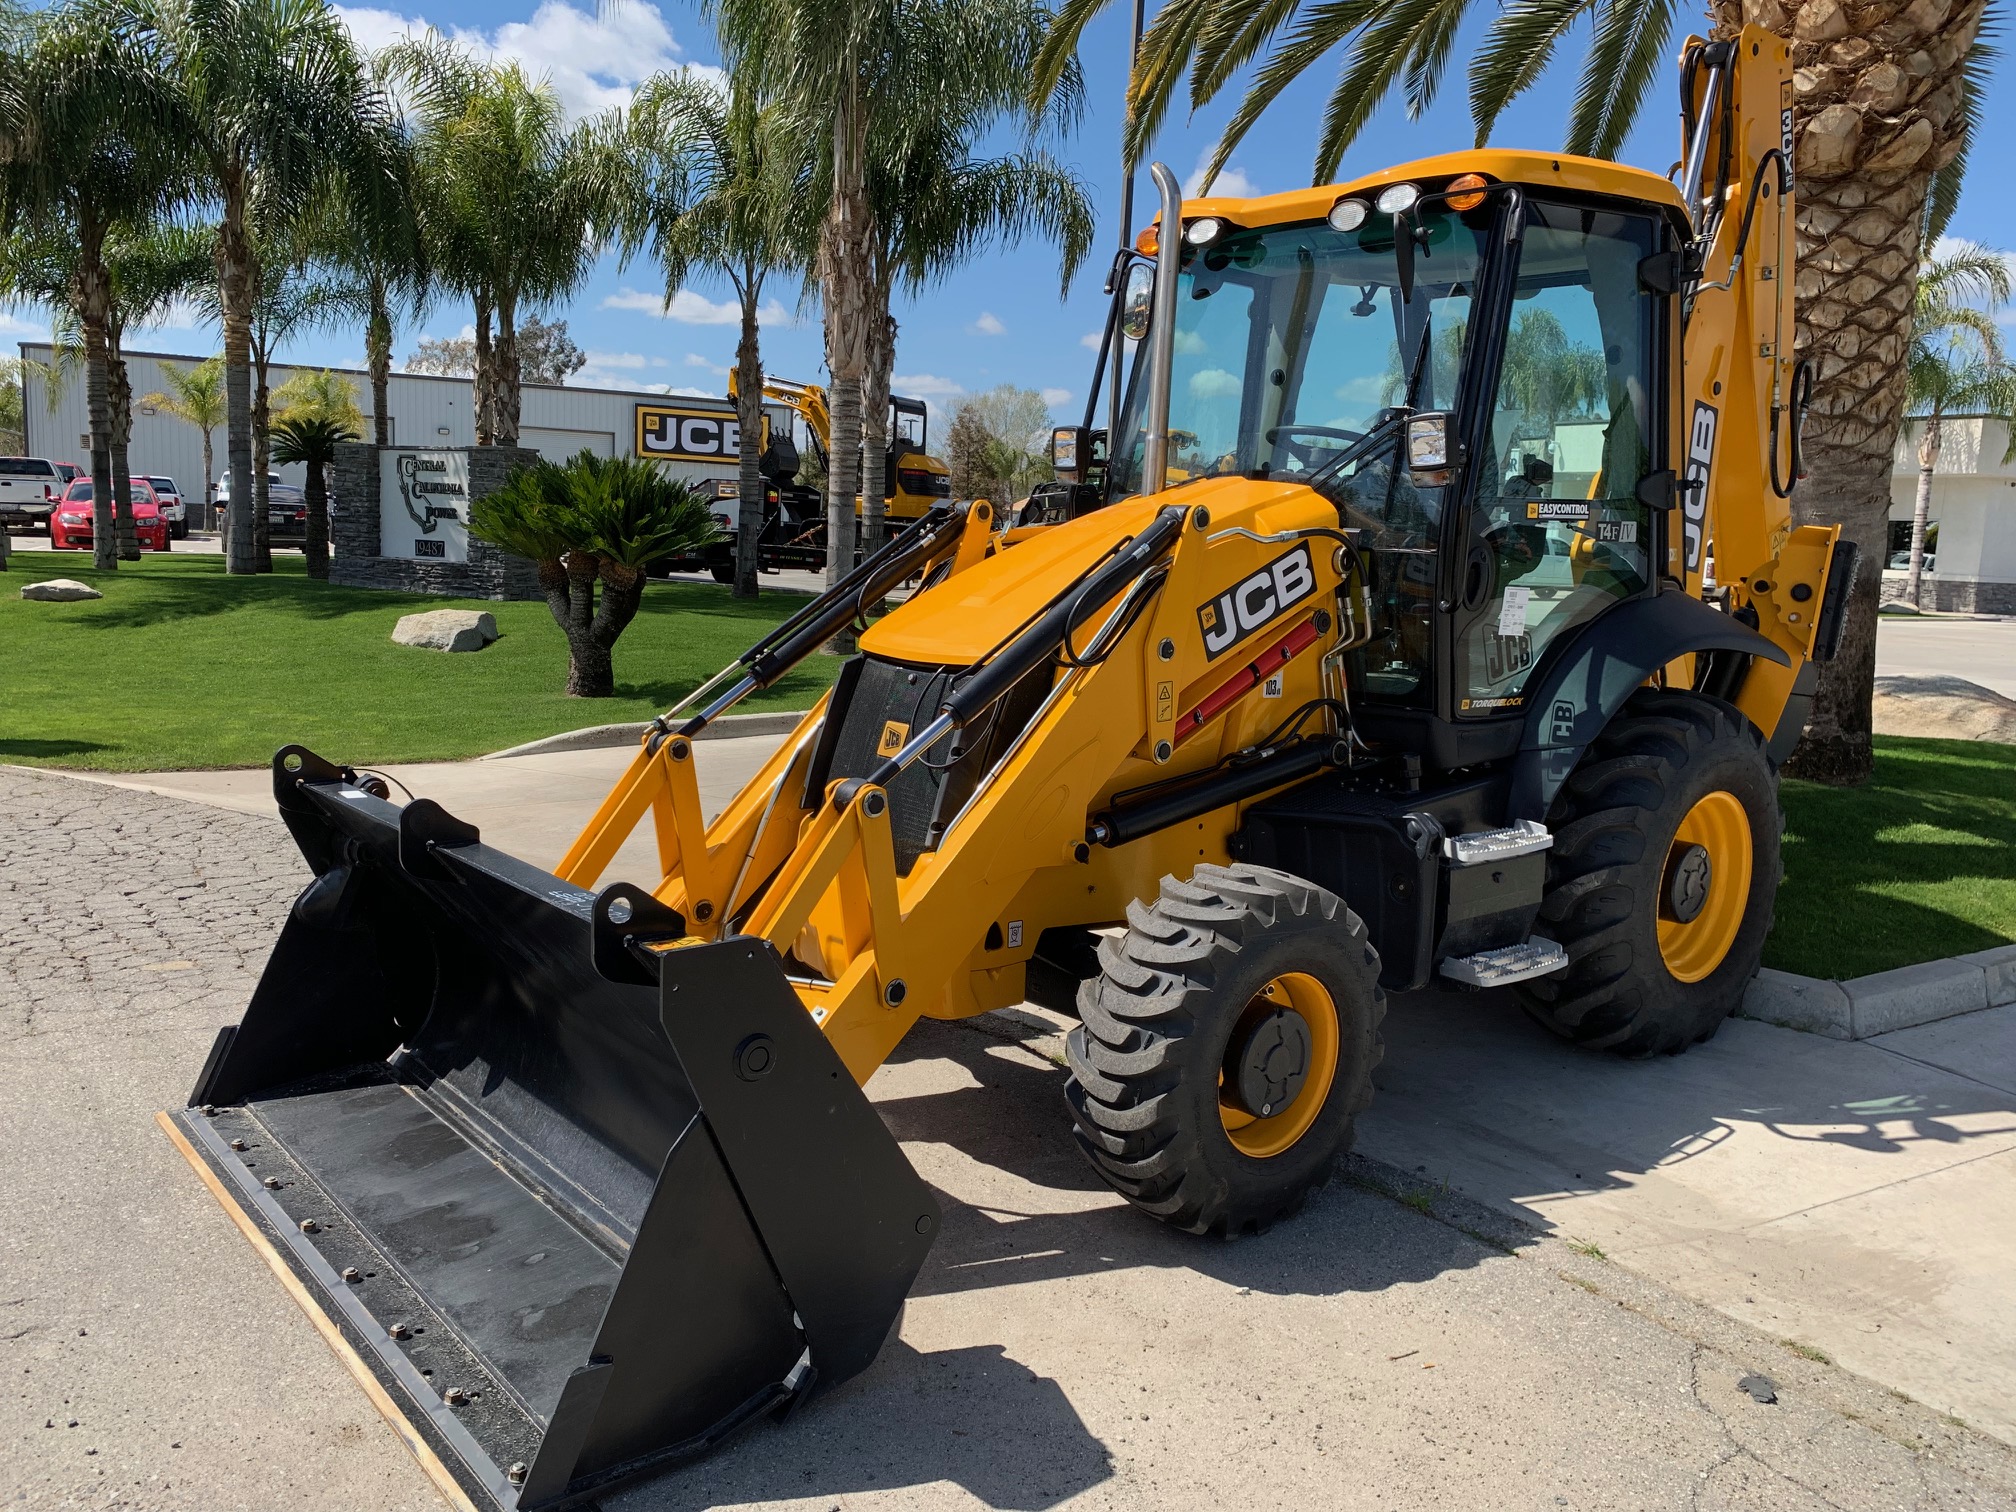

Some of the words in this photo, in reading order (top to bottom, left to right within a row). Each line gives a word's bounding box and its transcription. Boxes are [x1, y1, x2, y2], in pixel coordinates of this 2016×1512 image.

[779, 393, 800, 406] JCB
[404, 459, 447, 477] CENTRAL
[411, 481, 464, 499] CALIFORNIA
[1685, 407, 1716, 568] JCB
[425, 506, 458, 524] POWER
[416, 540, 444, 556] 19487
[1206, 549, 1313, 652] JCB
[1490, 631, 1530, 679] JCB
[1265, 680, 1277, 696] 103
[1471, 697, 1523, 708] TORQUELOCK
[886, 729, 901, 747] JCB
